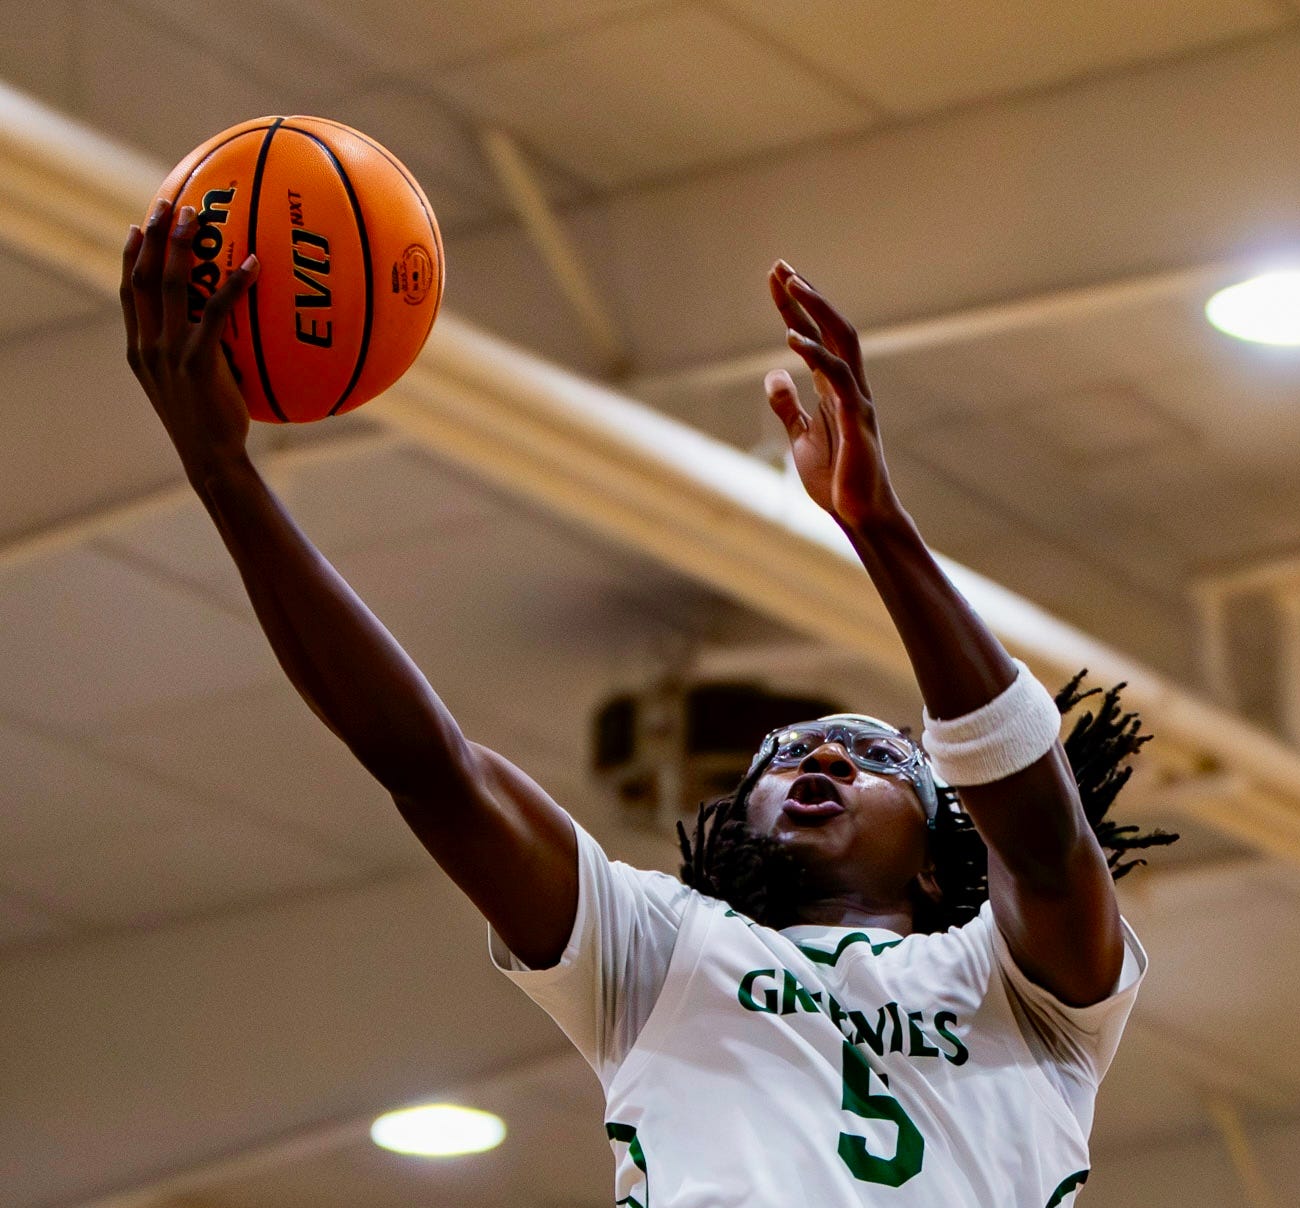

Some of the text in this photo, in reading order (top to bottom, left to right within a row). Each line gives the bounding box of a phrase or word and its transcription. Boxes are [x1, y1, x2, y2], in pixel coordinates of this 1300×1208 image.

[287, 189, 333, 349] EVO NXT
[837, 1039, 925, 1188] 5
